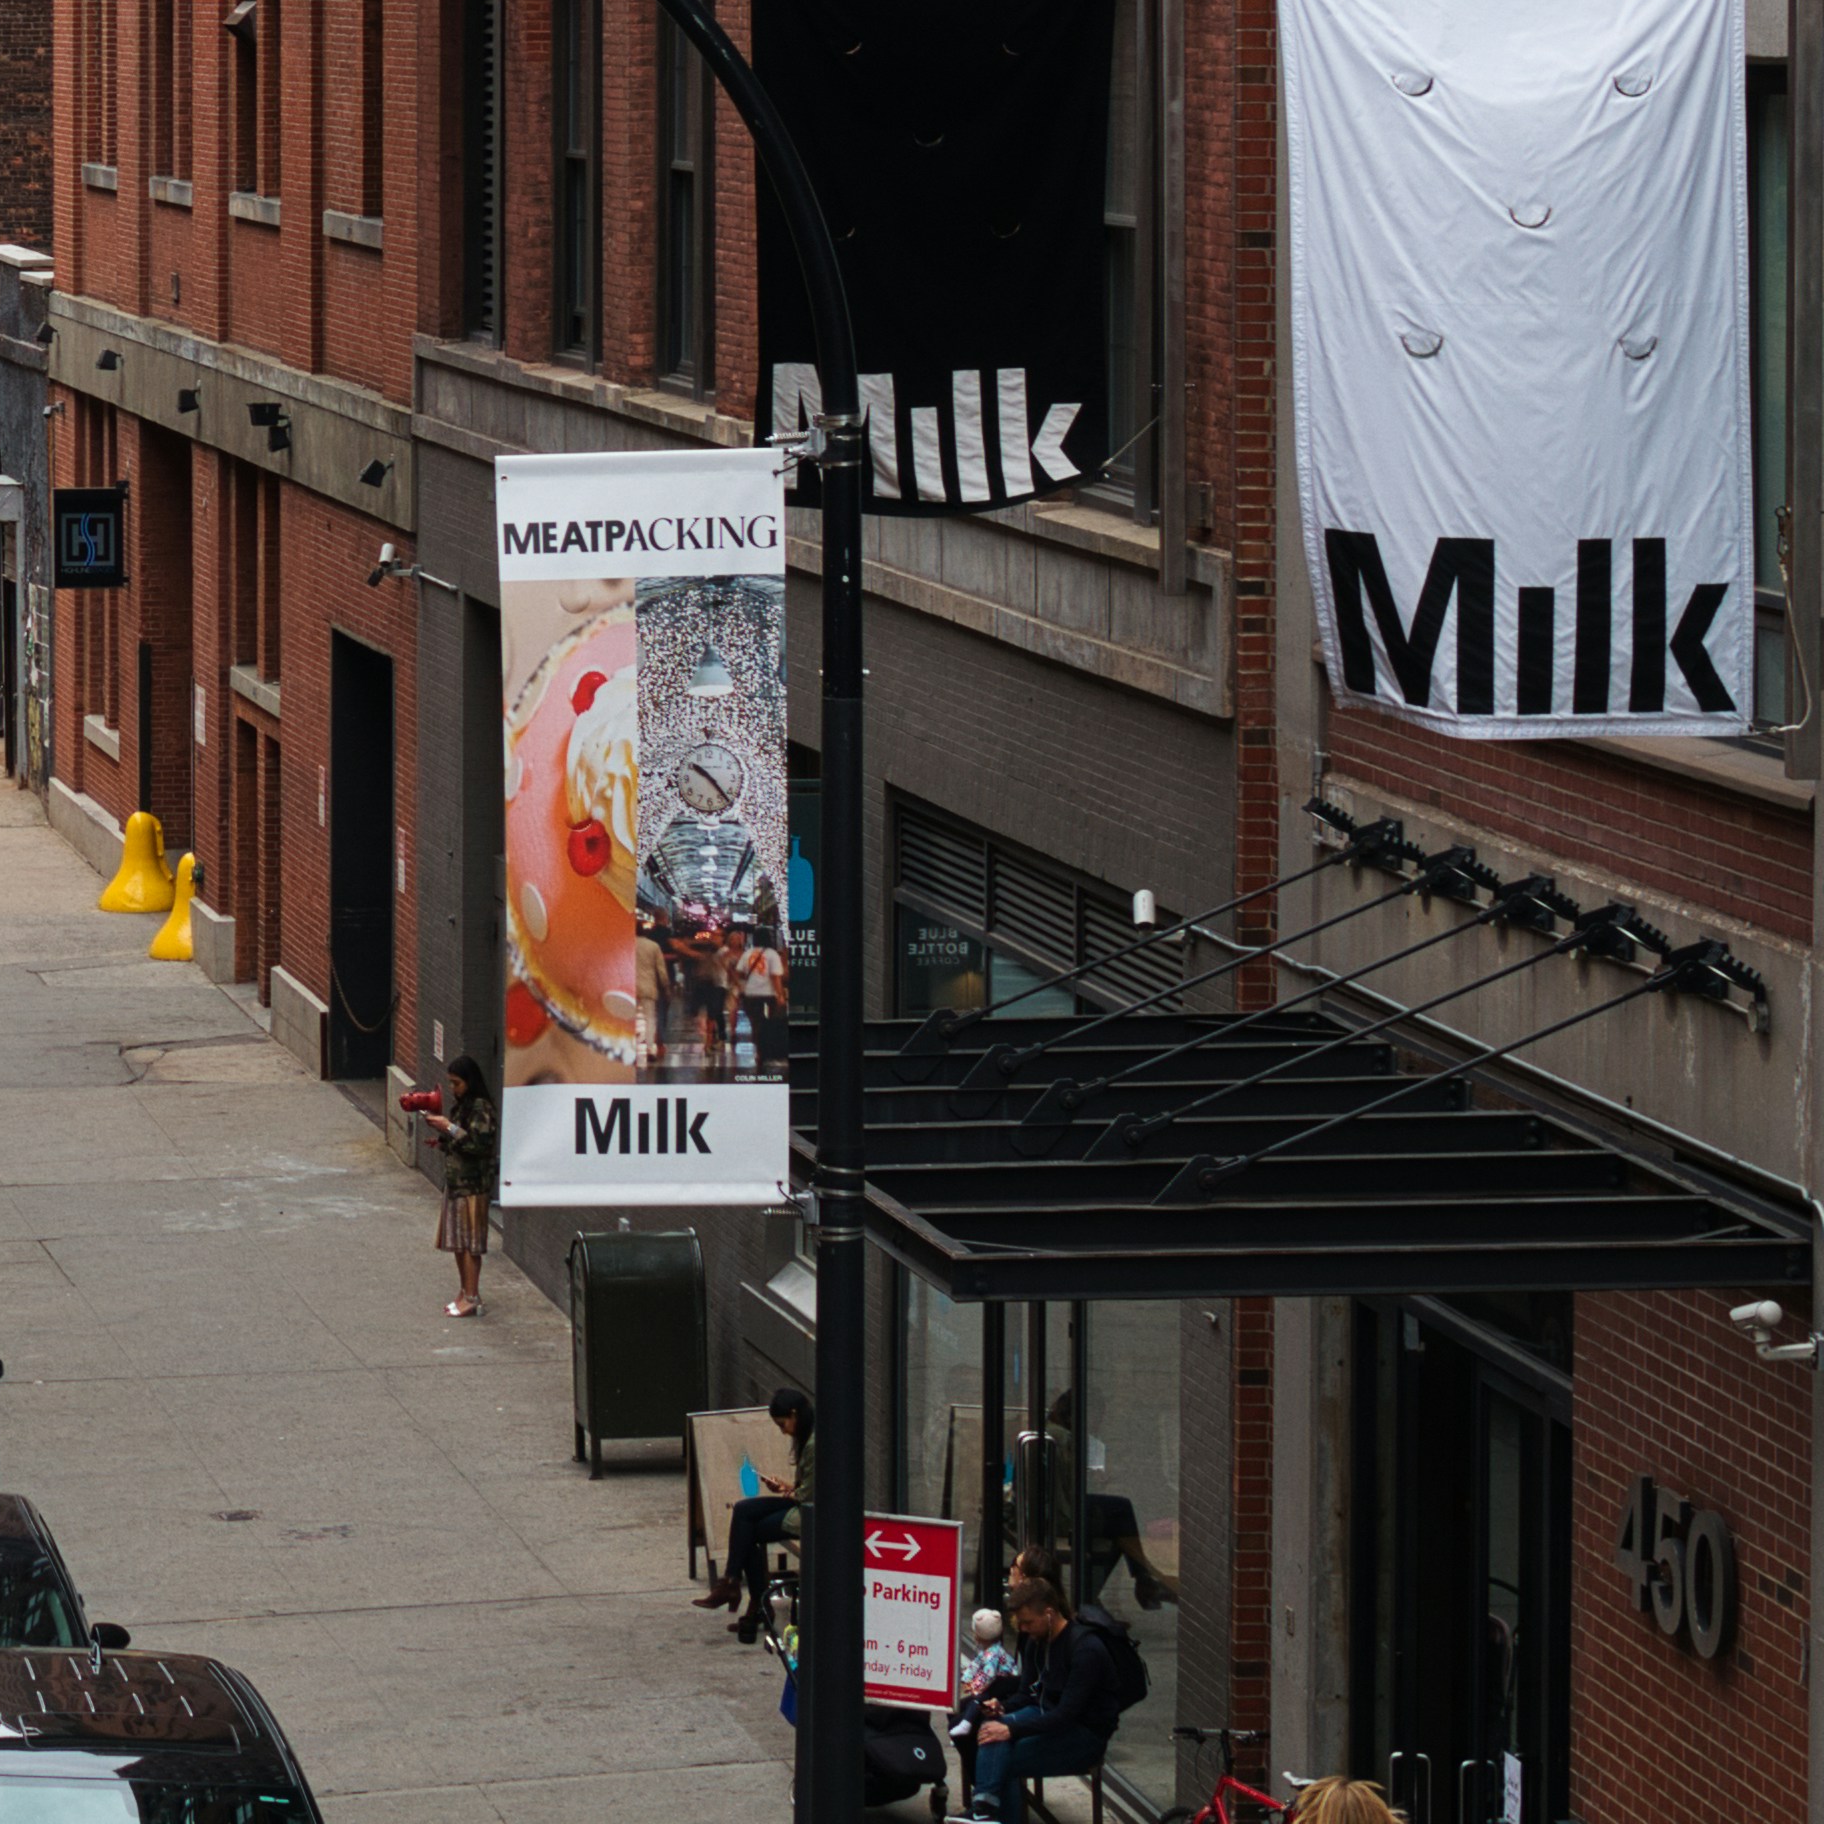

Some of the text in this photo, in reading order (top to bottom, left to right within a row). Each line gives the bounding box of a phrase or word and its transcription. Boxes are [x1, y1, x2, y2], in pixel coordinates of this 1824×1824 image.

[502, 514, 778, 555] MEATPACKING
[1323, 527, 1737, 716] Milk
[789, 929, 816, 942] LUE
[789, 944, 821, 957] TTL
[574, 1097, 713, 1155] Milk
[1613, 1472, 1738, 1661] 450
[872, 1580, 941, 1611] Parking
[897, 1639, 905, 1654] 6
[908, 1642, 929, 1658] pm
[864, 1659, 890, 1676] nday
[899, 1662, 933, 1681] Friday
